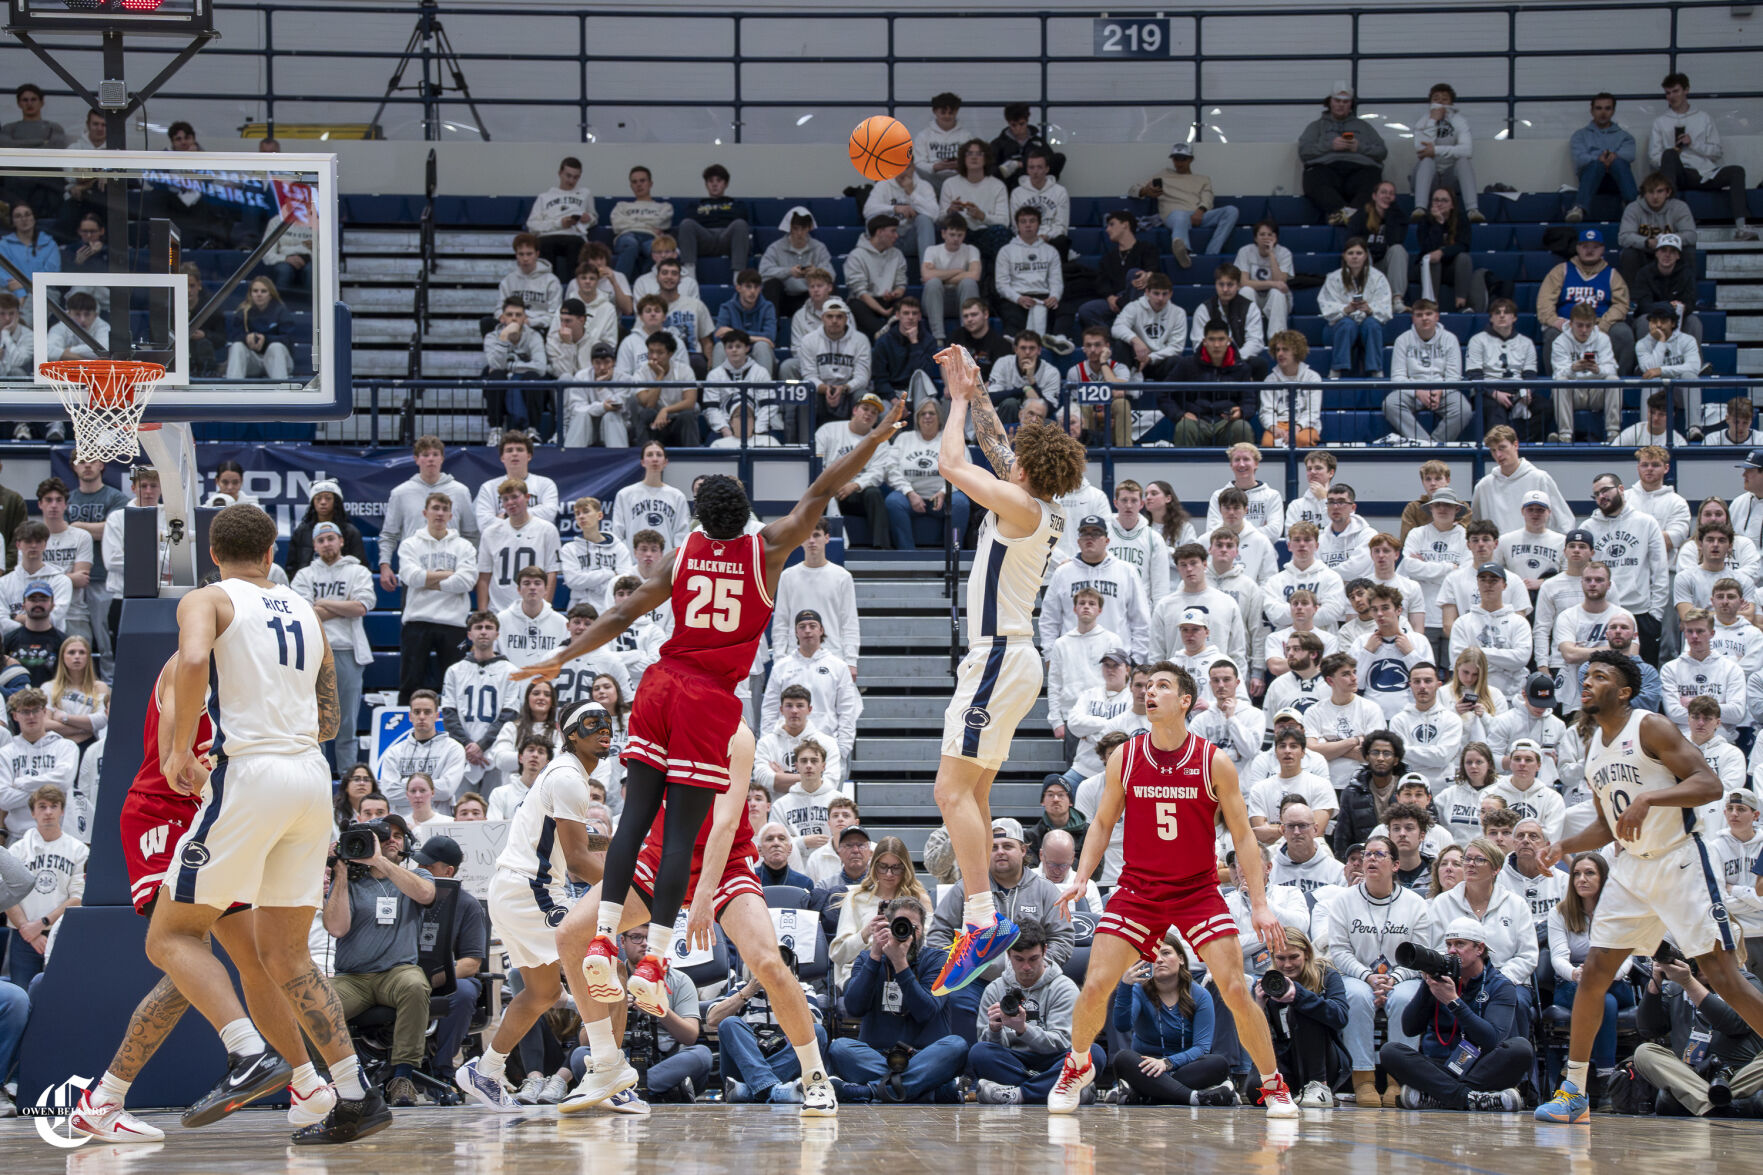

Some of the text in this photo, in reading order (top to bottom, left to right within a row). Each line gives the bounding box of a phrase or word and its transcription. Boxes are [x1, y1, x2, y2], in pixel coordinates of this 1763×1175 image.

[1103, 24, 1161, 51] 219
[777, 386, 807, 401] 119
[1078, 385, 1111, 401] 120
[631, 499, 675, 522] PENN STATE
[1615, 530, 1640, 548] STATE
[1511, 544, 1558, 562] PENN STATE
[1620, 557, 1638, 567] LIONS
[499, 547, 536, 586] 10
[687, 558, 744, 575] BLACKWELL
[261, 597, 292, 615] RICE
[684, 574, 744, 633] 25
[266, 616, 306, 671] 11
[531, 635, 556, 650] STATE
[463, 684, 498, 723] 10
[1610, 764, 1643, 786] STATE
[1133, 786, 1199, 800] WISCONSIN
[787, 807, 809, 826] PENN
[1156, 802, 1179, 841] 5
[47, 854, 75, 876] STATE
[1020, 905, 1036, 913] PSU
[1350, 918, 1410, 936] Penn State
